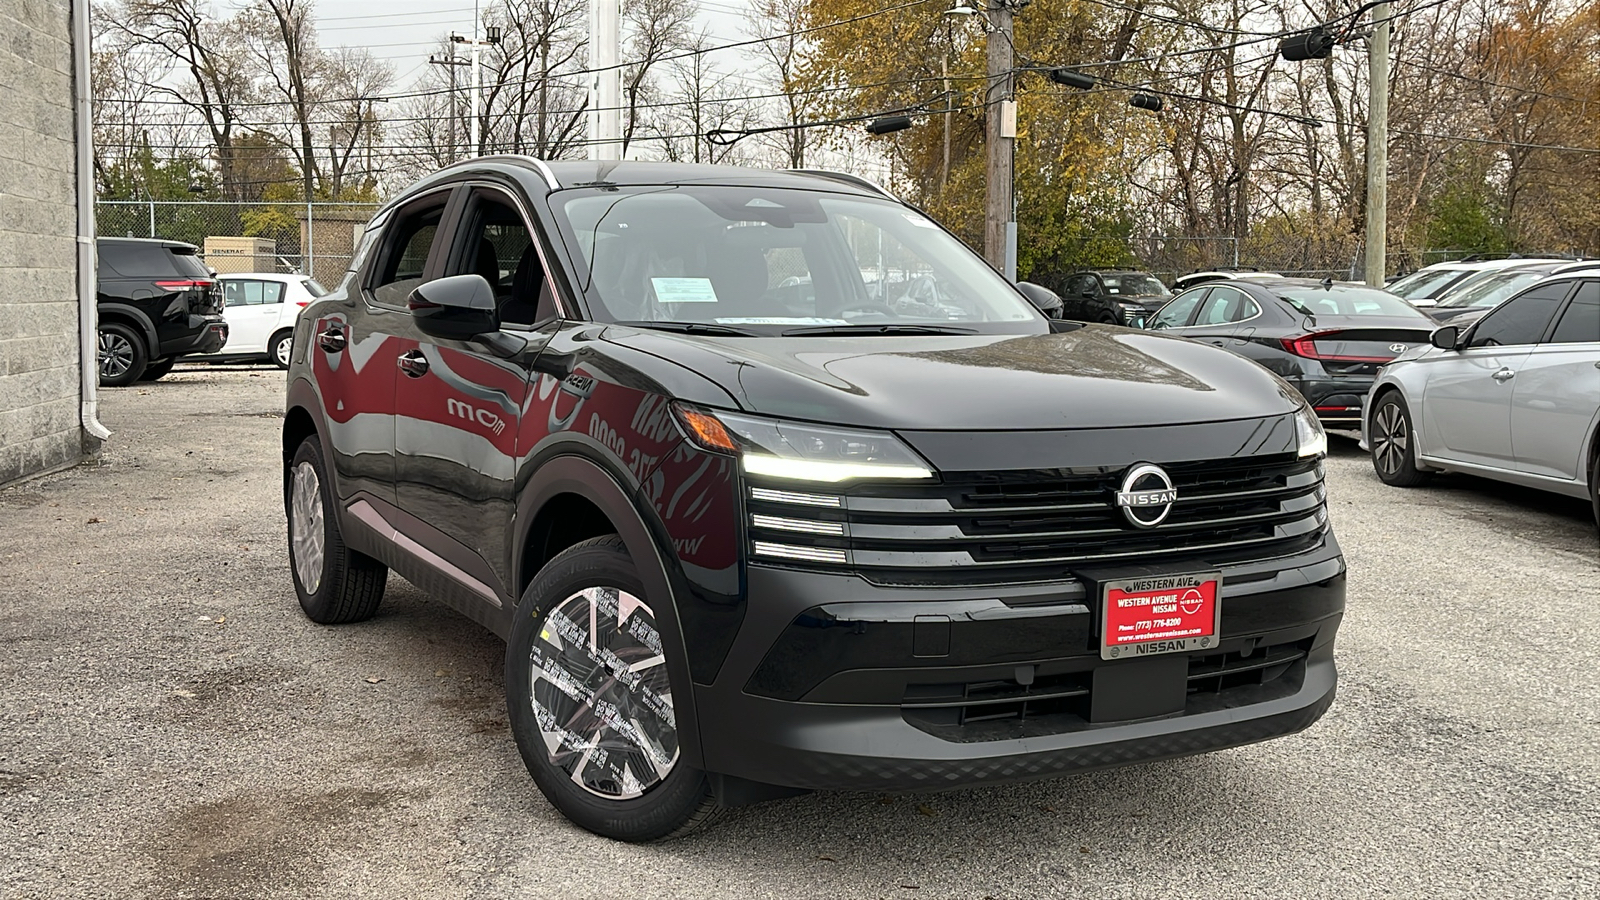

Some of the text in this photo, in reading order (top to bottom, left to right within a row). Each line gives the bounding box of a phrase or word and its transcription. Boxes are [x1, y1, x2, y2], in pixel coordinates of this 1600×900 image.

[1119, 491, 1177, 505] NISSAN
[1133, 577, 1193, 591] WESTERN AVE
[1117, 594, 1178, 608] WESTERN AVENUE
[1152, 604, 1177, 614] NISSAN
[1135, 620, 1152, 632] (773)
[1153, 617, 1181, 628] 776-8200
[1117, 628, 1202, 642] www.westernavenissan.com
[1136, 640, 1185, 655] NISSAN
